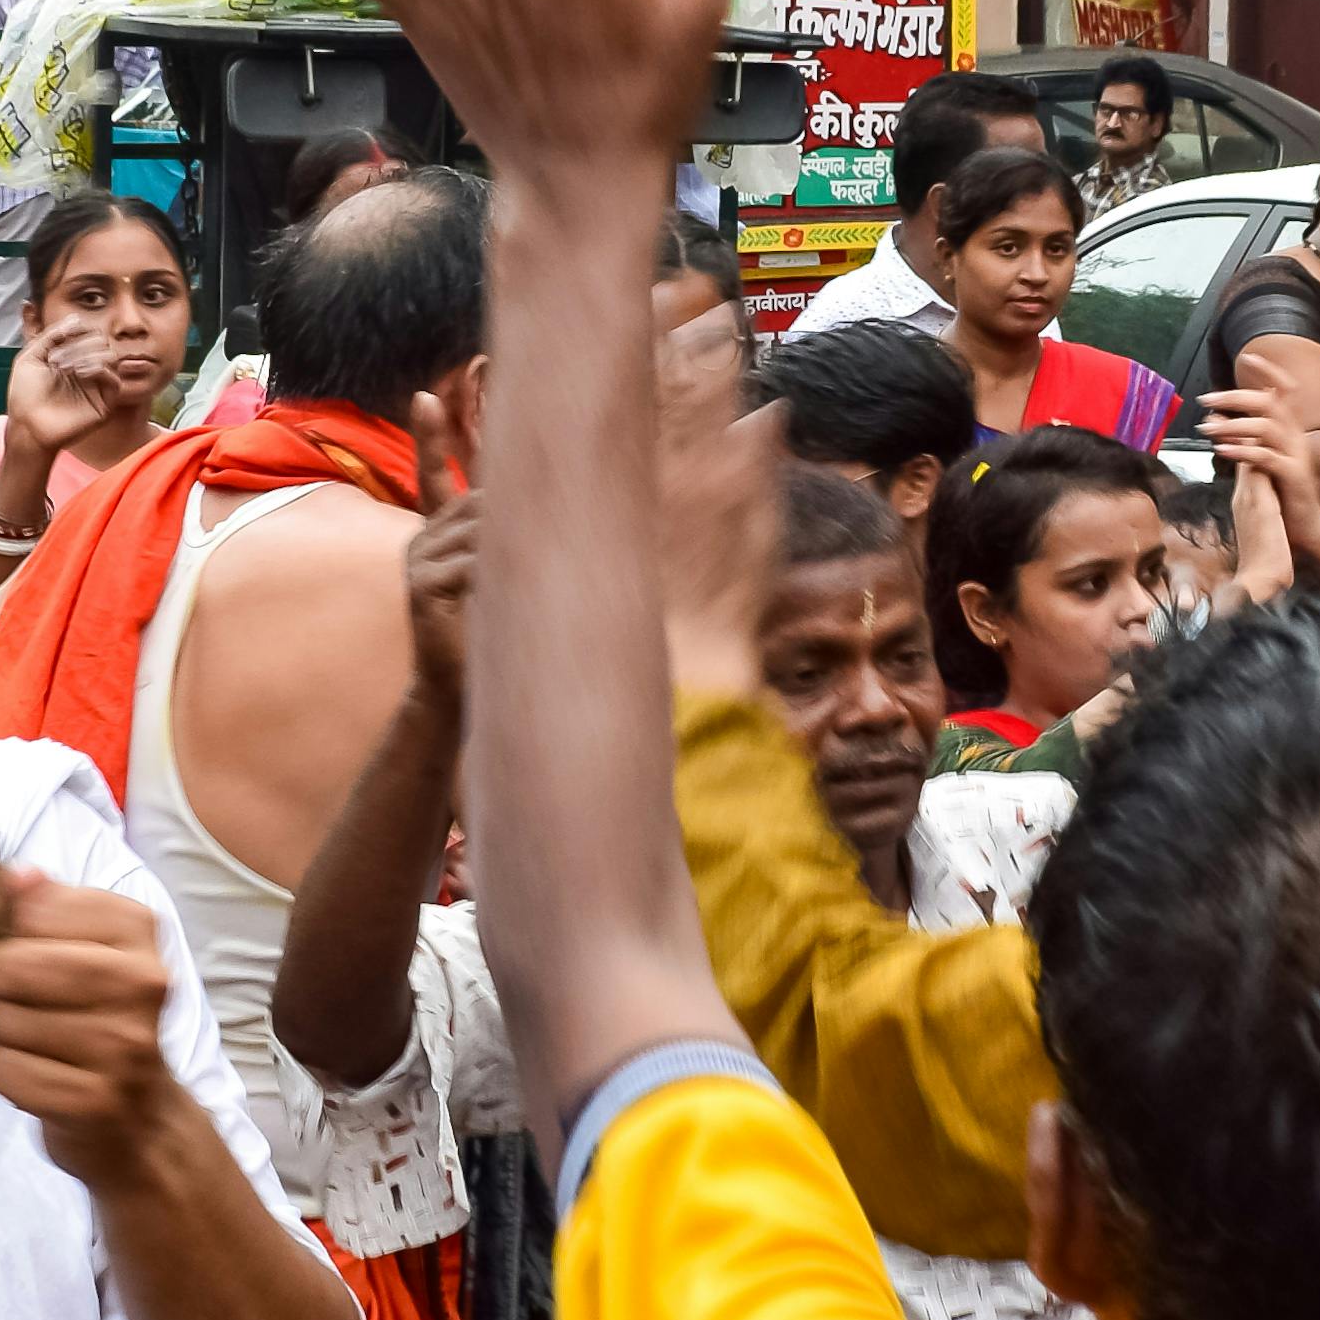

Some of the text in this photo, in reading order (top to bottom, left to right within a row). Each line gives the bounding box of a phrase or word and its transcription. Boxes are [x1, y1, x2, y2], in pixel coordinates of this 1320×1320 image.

[810, 90, 853, 140] की
[801, 152, 845, 177] स्पेशल
[830, 180, 877, 205] फलूदा
[743, 287, 806, 318] हावीराय
